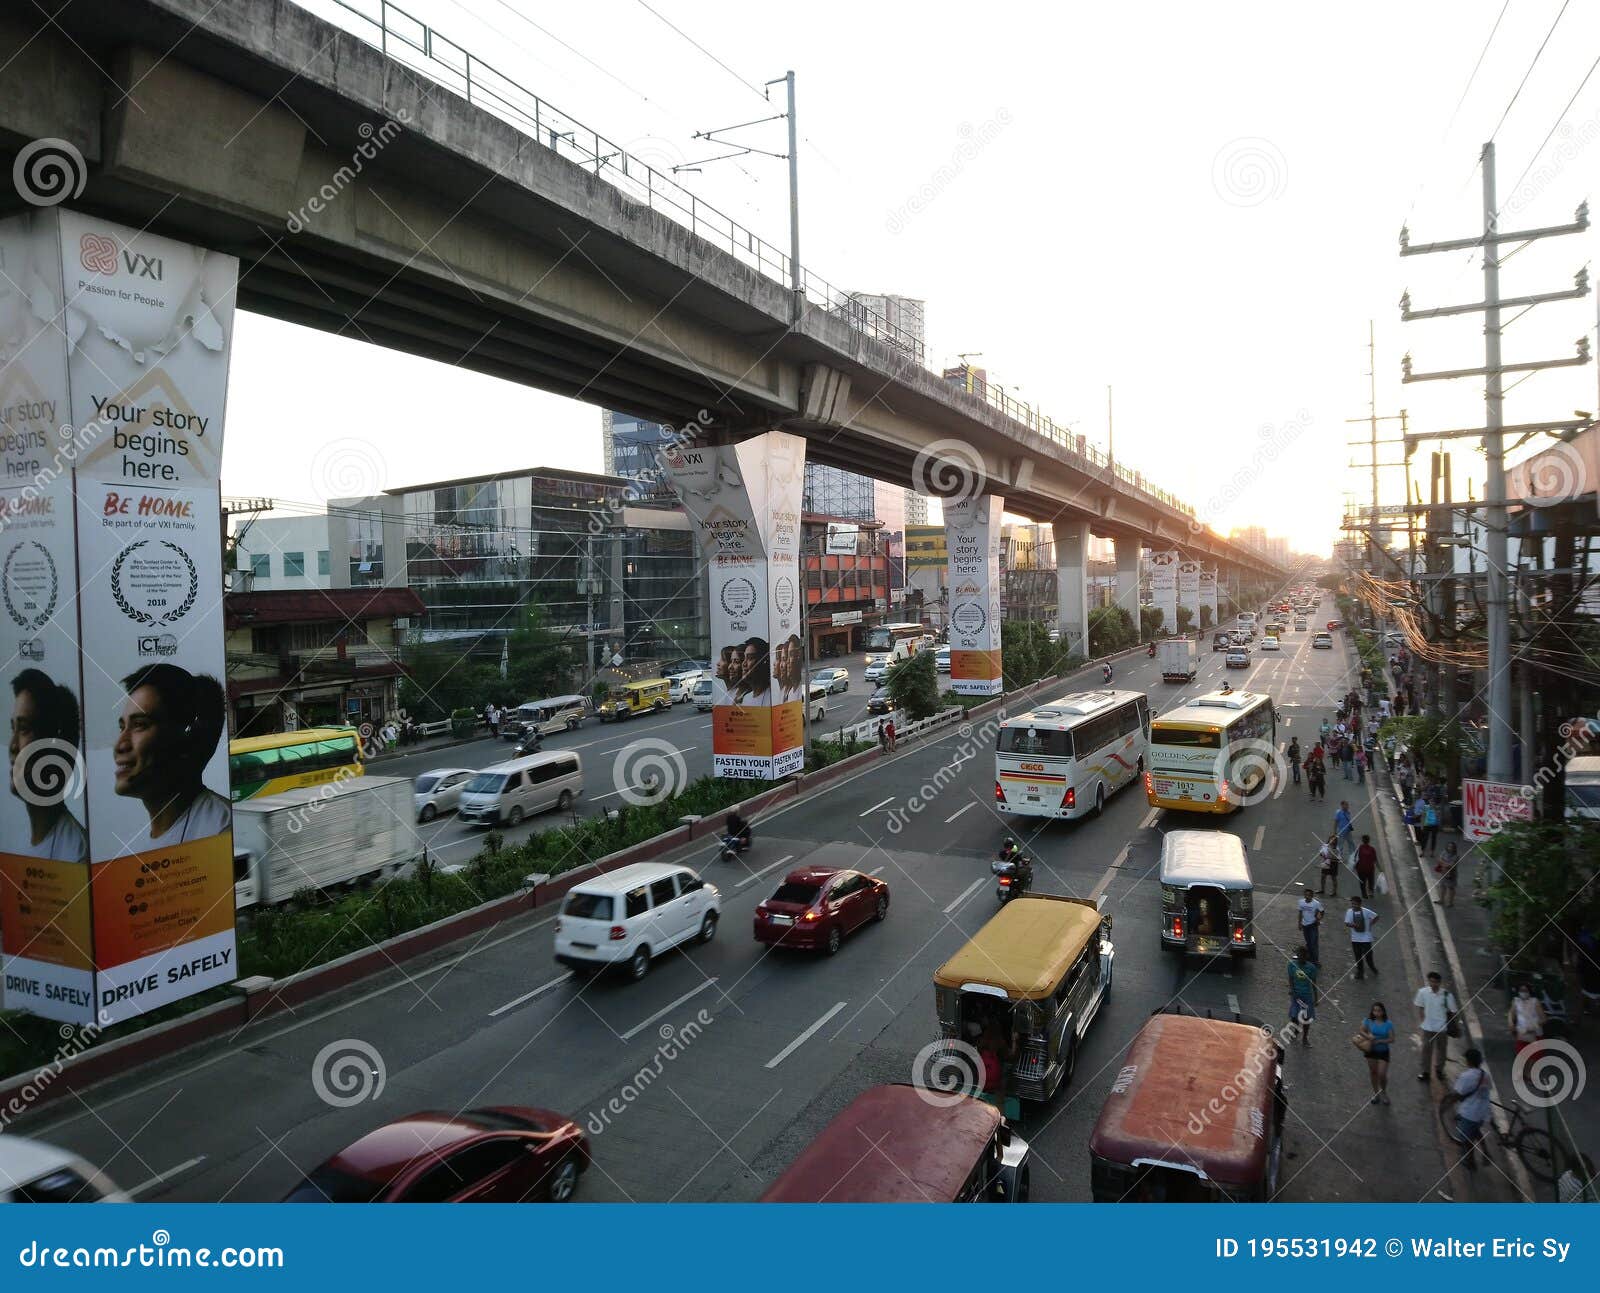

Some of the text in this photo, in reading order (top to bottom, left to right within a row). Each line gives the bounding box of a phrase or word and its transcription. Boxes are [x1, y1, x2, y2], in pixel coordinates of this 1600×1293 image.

[123, 250, 163, 281] VXI
[78, 280, 165, 308] Passion for People
[18, 399, 57, 424] story
[91, 395, 209, 437] Your story
[113, 427, 189, 457] begins
[683, 453, 704, 465] VXI
[6, 458, 41, 480] here
[122, 455, 180, 481] here.
[102, 518, 114, 527] Be
[115, 519, 132, 529] part
[134, 520, 142, 528] of
[143, 521, 156, 529] our
[159, 520, 171, 529] VXI
[698, 519, 748, 530] Your story
[711, 529, 744, 540] begins
[957, 535, 977, 544] Your
[719, 539, 745, 549] here.
[956, 546, 979, 555] story
[953, 555, 982, 565] begins
[957, 565, 979, 573] here.
[147, 599, 167, 607] 2018
[138, 638, 160, 652] ICT
[715, 757, 771, 768] FASTEN YOUR
[774, 750, 803, 766] FASTEN YOUR
[723, 768, 763, 777] SEATBELT
[778, 761, 800, 775] SEATBELT
[1465, 783, 1486, 817] NO
[102, 948, 232, 1008] DRIVE SAFELY
[6, 974, 91, 1009] DRIVE SAFELY
